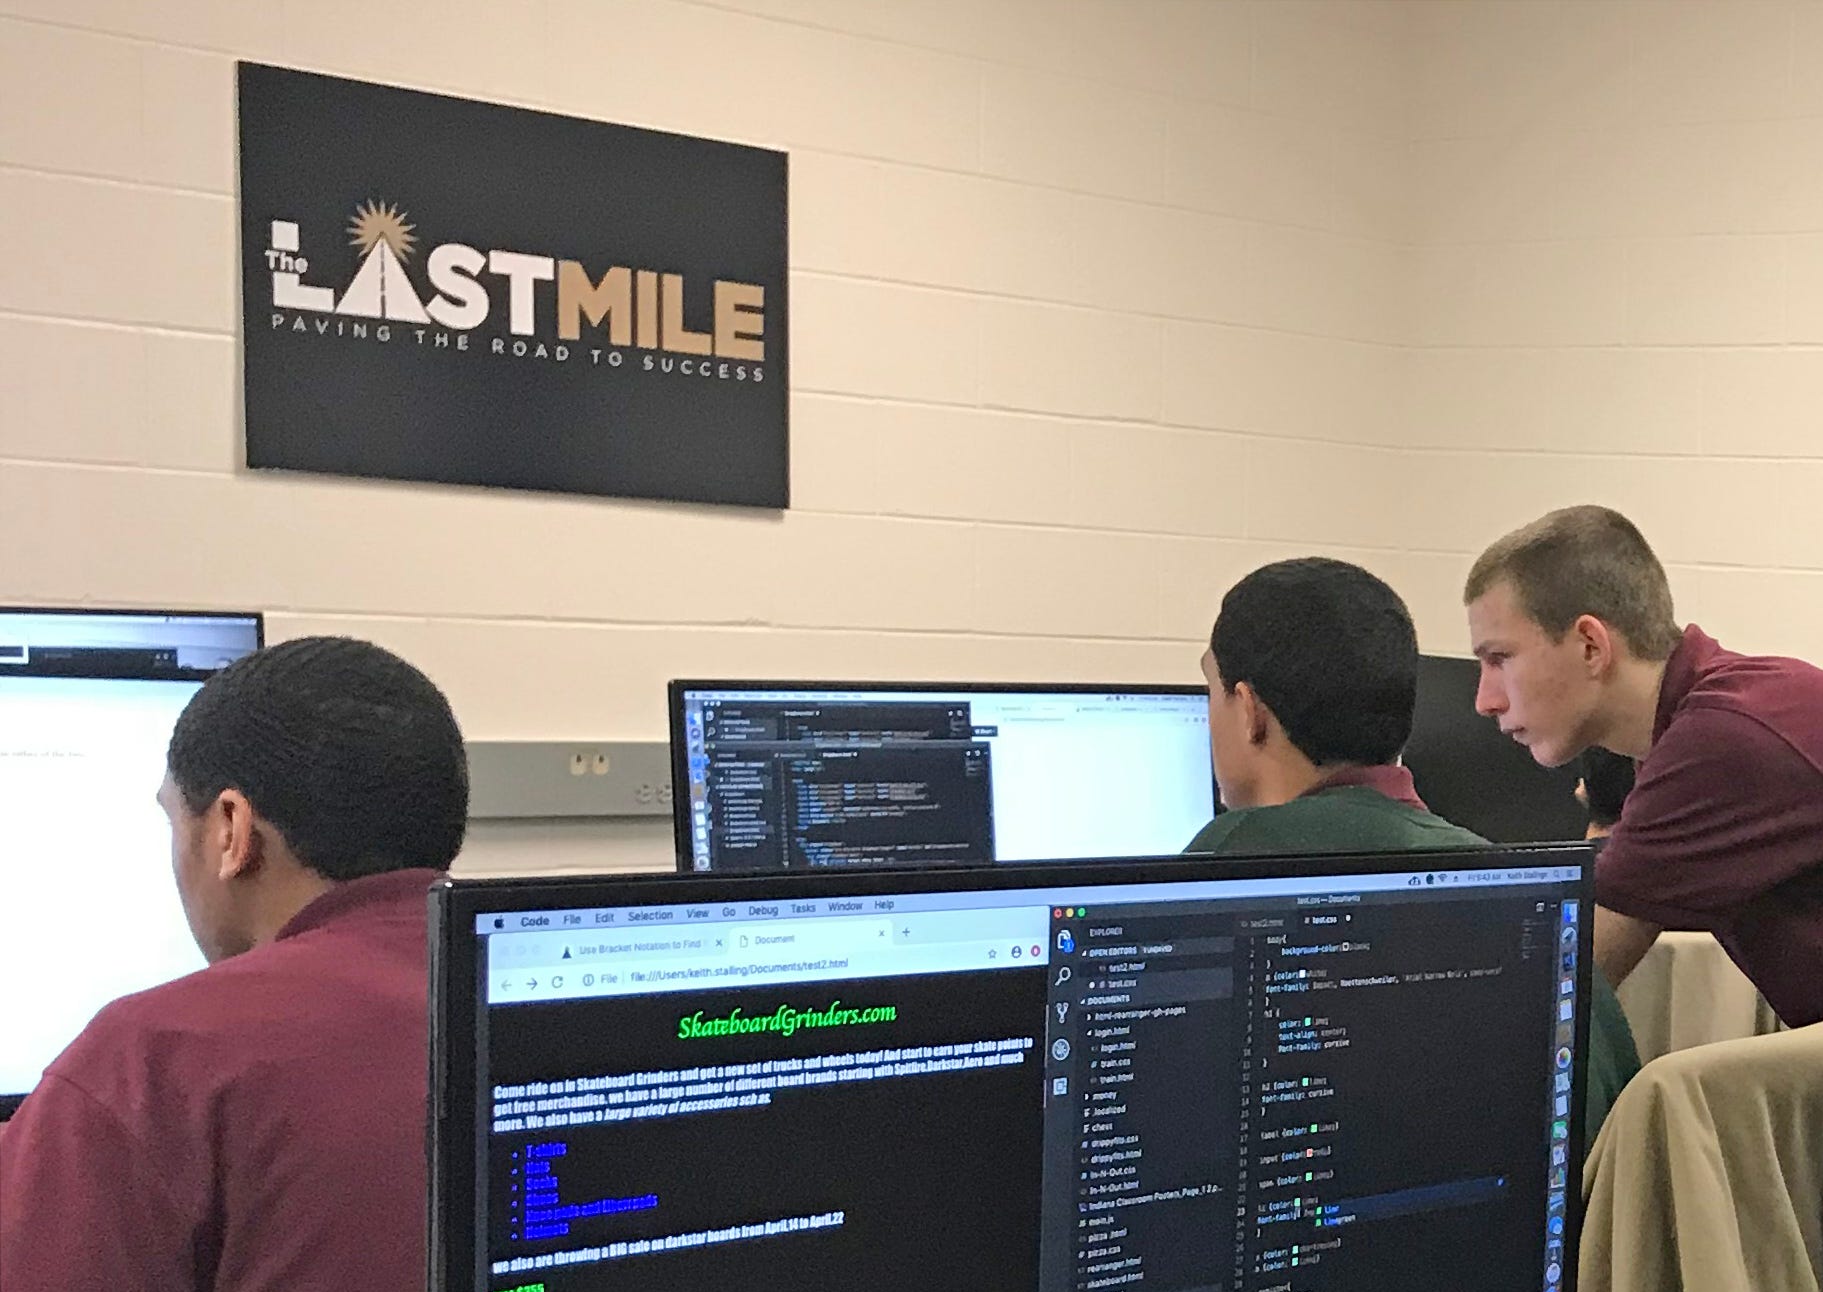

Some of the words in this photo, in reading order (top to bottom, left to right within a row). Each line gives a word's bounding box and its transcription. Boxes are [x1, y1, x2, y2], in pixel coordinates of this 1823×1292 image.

[266, 250, 308, 273] The
[272, 313, 390, 342] PAVING
[415, 329, 468, 350] THE
[492, 339, 569, 361] ROAD
[592, 348, 623, 367] TO
[643, 356, 764, 382] SUCCESS
[521, 917, 550, 927] Code
[563, 915, 581, 924] File
[596, 913, 614, 923] Edit
[628, 911, 673, 922] Selection
[687, 909, 709, 918] View
[722, 908, 736, 917] Go
[749, 906, 778, 916] Debug
[791, 904, 816, 914] Tasks
[828, 901, 863, 912] Window
[875, 900, 894, 911] Help
[580, 946, 596, 954] Use
[599, 944, 632, 953] Bracket
[634, 942, 669, 952] Notation
[672, 941, 681, 950] to
[684, 940, 700, 948] Find
[755, 935, 794, 945] Document
[601, 974, 617, 984] File
[678, 1001, 897, 1038] SkateboardGrinders.com
[493, 1102, 512, 1117] get
[513, 1100, 535, 1113] free
[608, 1092, 623, 1103] we
[625, 1089, 649, 1102] have
[658, 1086, 684, 1099] large
[685, 1081, 722, 1096] number
[724, 1079, 734, 1092] of
[735, 1076, 776, 1091] different
[777, 1072, 803, 1087] board
[805, 1069, 836, 1084] brands
[838, 1066, 872, 1080] starting
[874, 1063, 893, 1076] with
[984, 1053, 999, 1066] and
[1001, 1051, 1023, 1064] much
[494, 1085, 524, 1098] Come
[526, 1082, 548, 1096] ride
[549, 1081, 563, 1093] on
[565, 1079, 575, 1092] in
[577, 1073, 634, 1091] Skateboard
[636, 1070, 678, 1085] Grinders
[680, 1067, 698, 1081] and
[725, 1064, 745, 1076] new
[746, 1062, 760, 1074] set
[762, 1060, 772, 1073] of
[773, 1058, 802, 1071] trucks
[803, 1055, 820, 1068] and
[822, 1053, 854, 1067] wheels
[884, 1048, 900, 1061] And
[902, 1047, 922, 1059] start
[923, 1046, 932, 1057] to
[954, 1043, 972, 1055] your
[973, 1040, 996, 1052] skate
[997, 1038, 1022, 1051] points
[526, 1115, 543, 1128] We
[545, 1113, 567, 1126] also
[569, 1111, 594, 1124] have
[668, 1100, 679, 1113] of
[679, 1095, 738, 1112] accessories
[492, 1260, 508, 1273] we
[510, 1257, 533, 1271] also
[535, 1254, 552, 1267] are
[554, 1247, 600, 1264] throwing
[609, 1242, 626, 1257] BIG
[628, 1239, 649, 1254] sale
[651, 1238, 664, 1250] on
[666, 1232, 706, 1248] darkstar
[707, 1226, 740, 1242] boards
[741, 1224, 763, 1237] from
